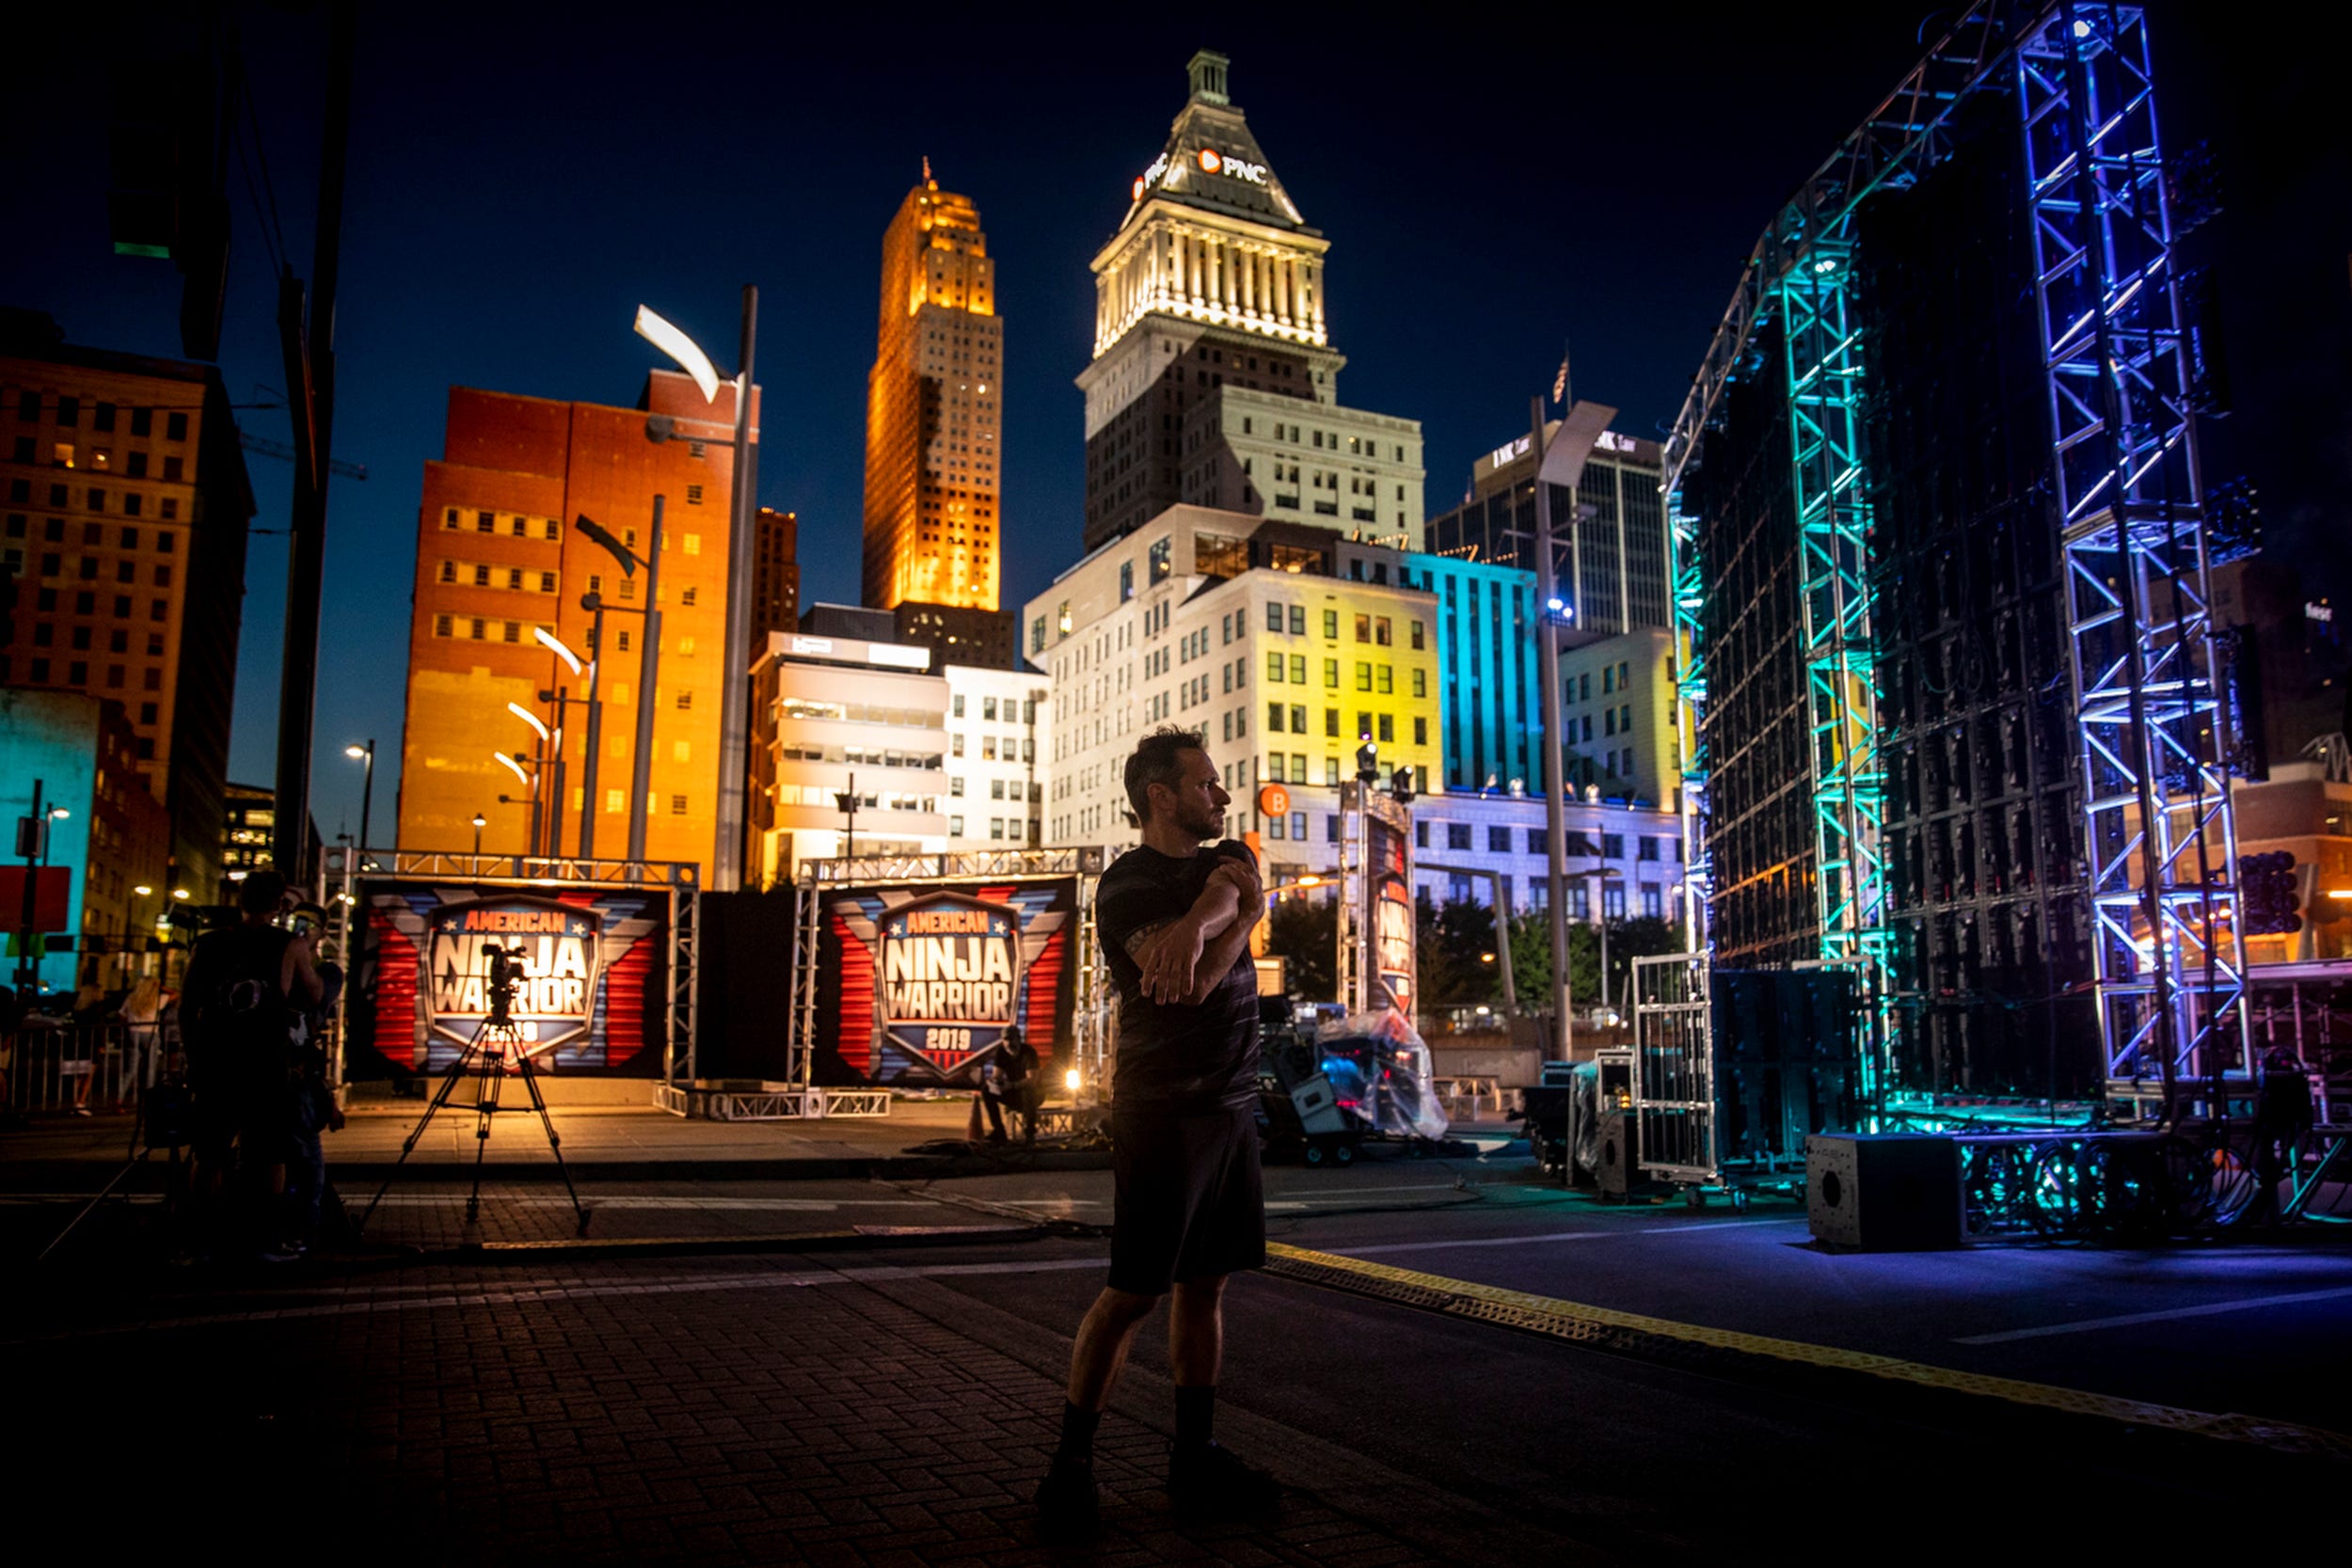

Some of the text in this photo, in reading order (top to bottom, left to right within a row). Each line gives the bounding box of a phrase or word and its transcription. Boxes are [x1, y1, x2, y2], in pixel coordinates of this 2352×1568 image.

[1222, 156, 1266, 185] PNC
[1273, 793, 1285, 812] B
[465, 911, 565, 932] AMERICAN
[906, 911, 990, 933] AMERICAN
[886, 937, 1012, 982] NINJA
[434, 975, 584, 1013] WARIOR
[887, 981, 1009, 1020] WARRIOR
[926, 1028, 971, 1051] 2019
